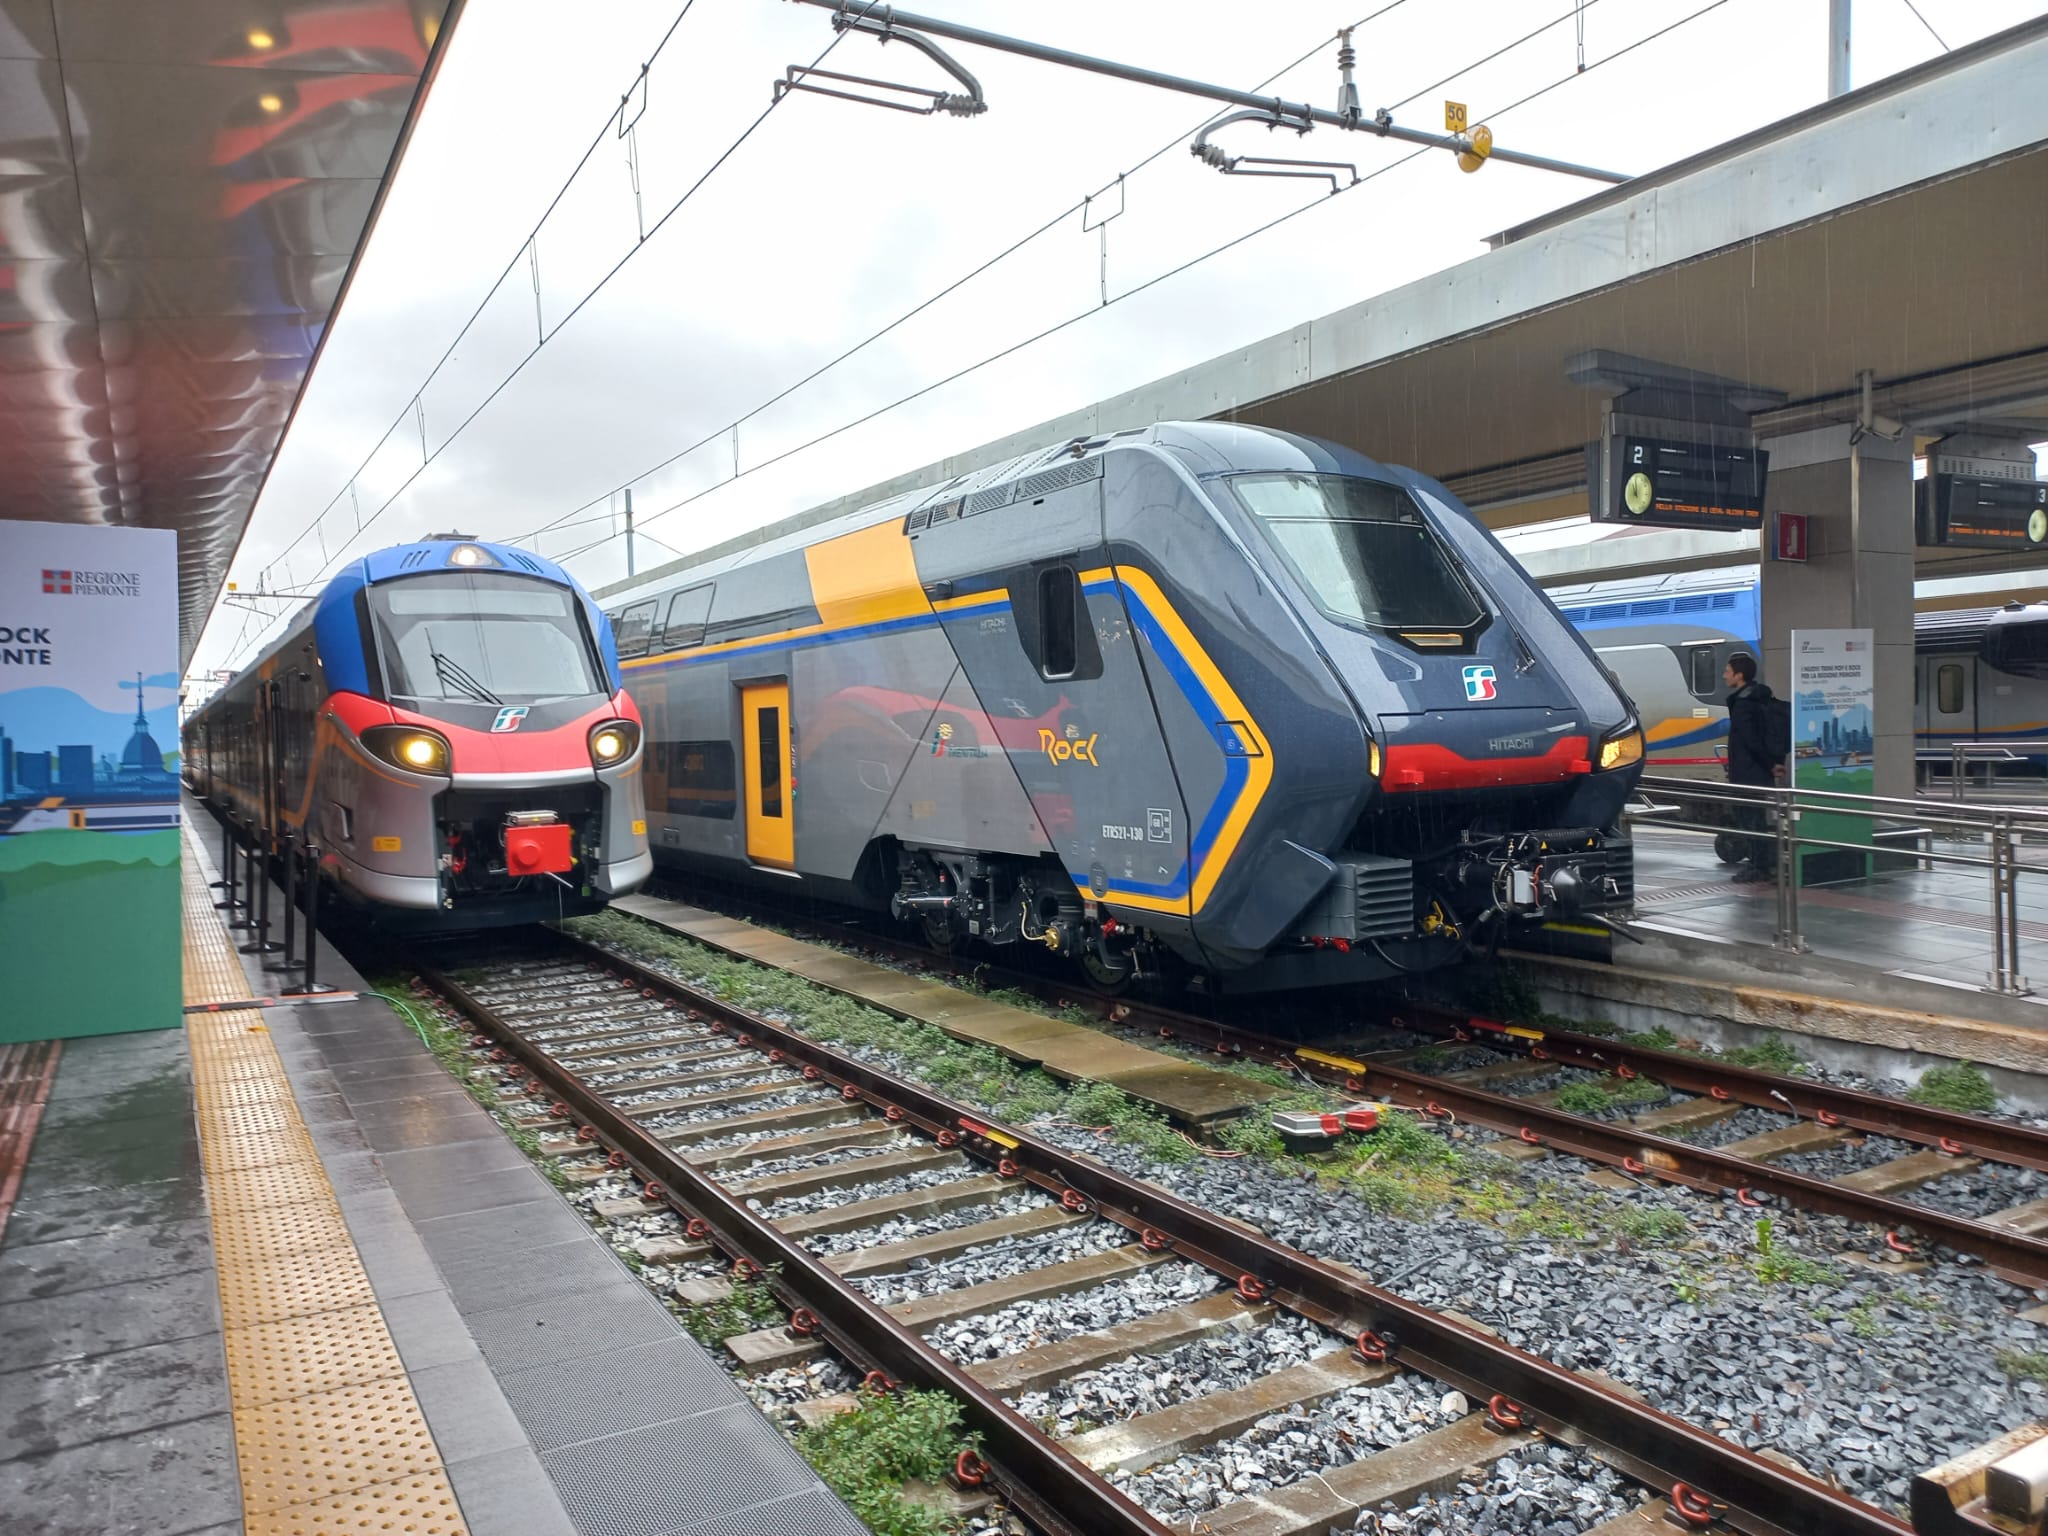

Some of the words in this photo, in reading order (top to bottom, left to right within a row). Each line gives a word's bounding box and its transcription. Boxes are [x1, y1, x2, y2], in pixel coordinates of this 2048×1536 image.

[1448, 105, 1464, 122] 50
[1633, 446, 1643, 464] 2
[2039, 488, 2047, 503] 3
[74, 571, 141, 585] REGIONE
[74, 584, 141, 597] PIEMONTE
[0, 627, 52, 645] OCK
[0, 648, 52, 665] NTE
[1489, 739, 1534, 750] HITACHI
